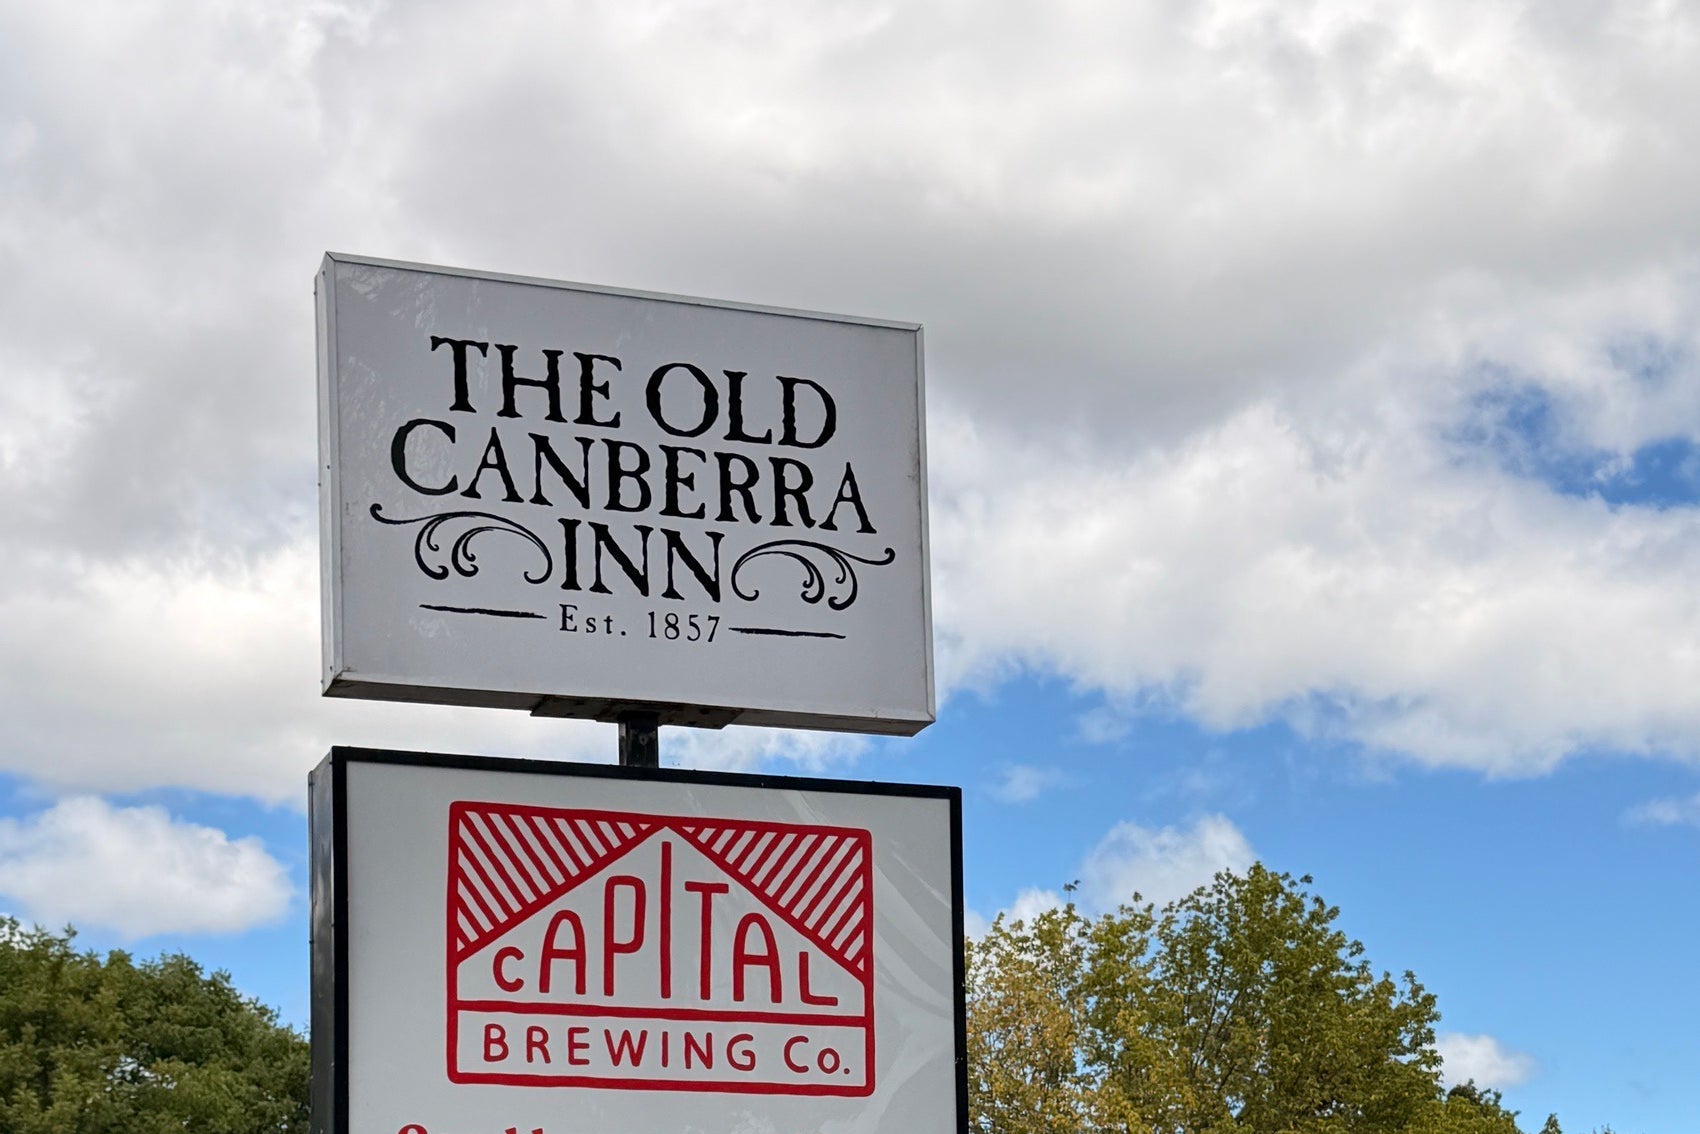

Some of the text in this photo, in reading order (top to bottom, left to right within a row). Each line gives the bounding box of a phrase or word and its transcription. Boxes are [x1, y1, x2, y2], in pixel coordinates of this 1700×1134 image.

[429, 335, 837, 450] THE OLD
[390, 418, 878, 535] CANBERRA
[557, 517, 726, 604] INN
[558, 603, 721, 643] Est. 1857
[492, 841, 839, 1007] CAPITAL
[483, 1023, 851, 1076] BREWING Co.
